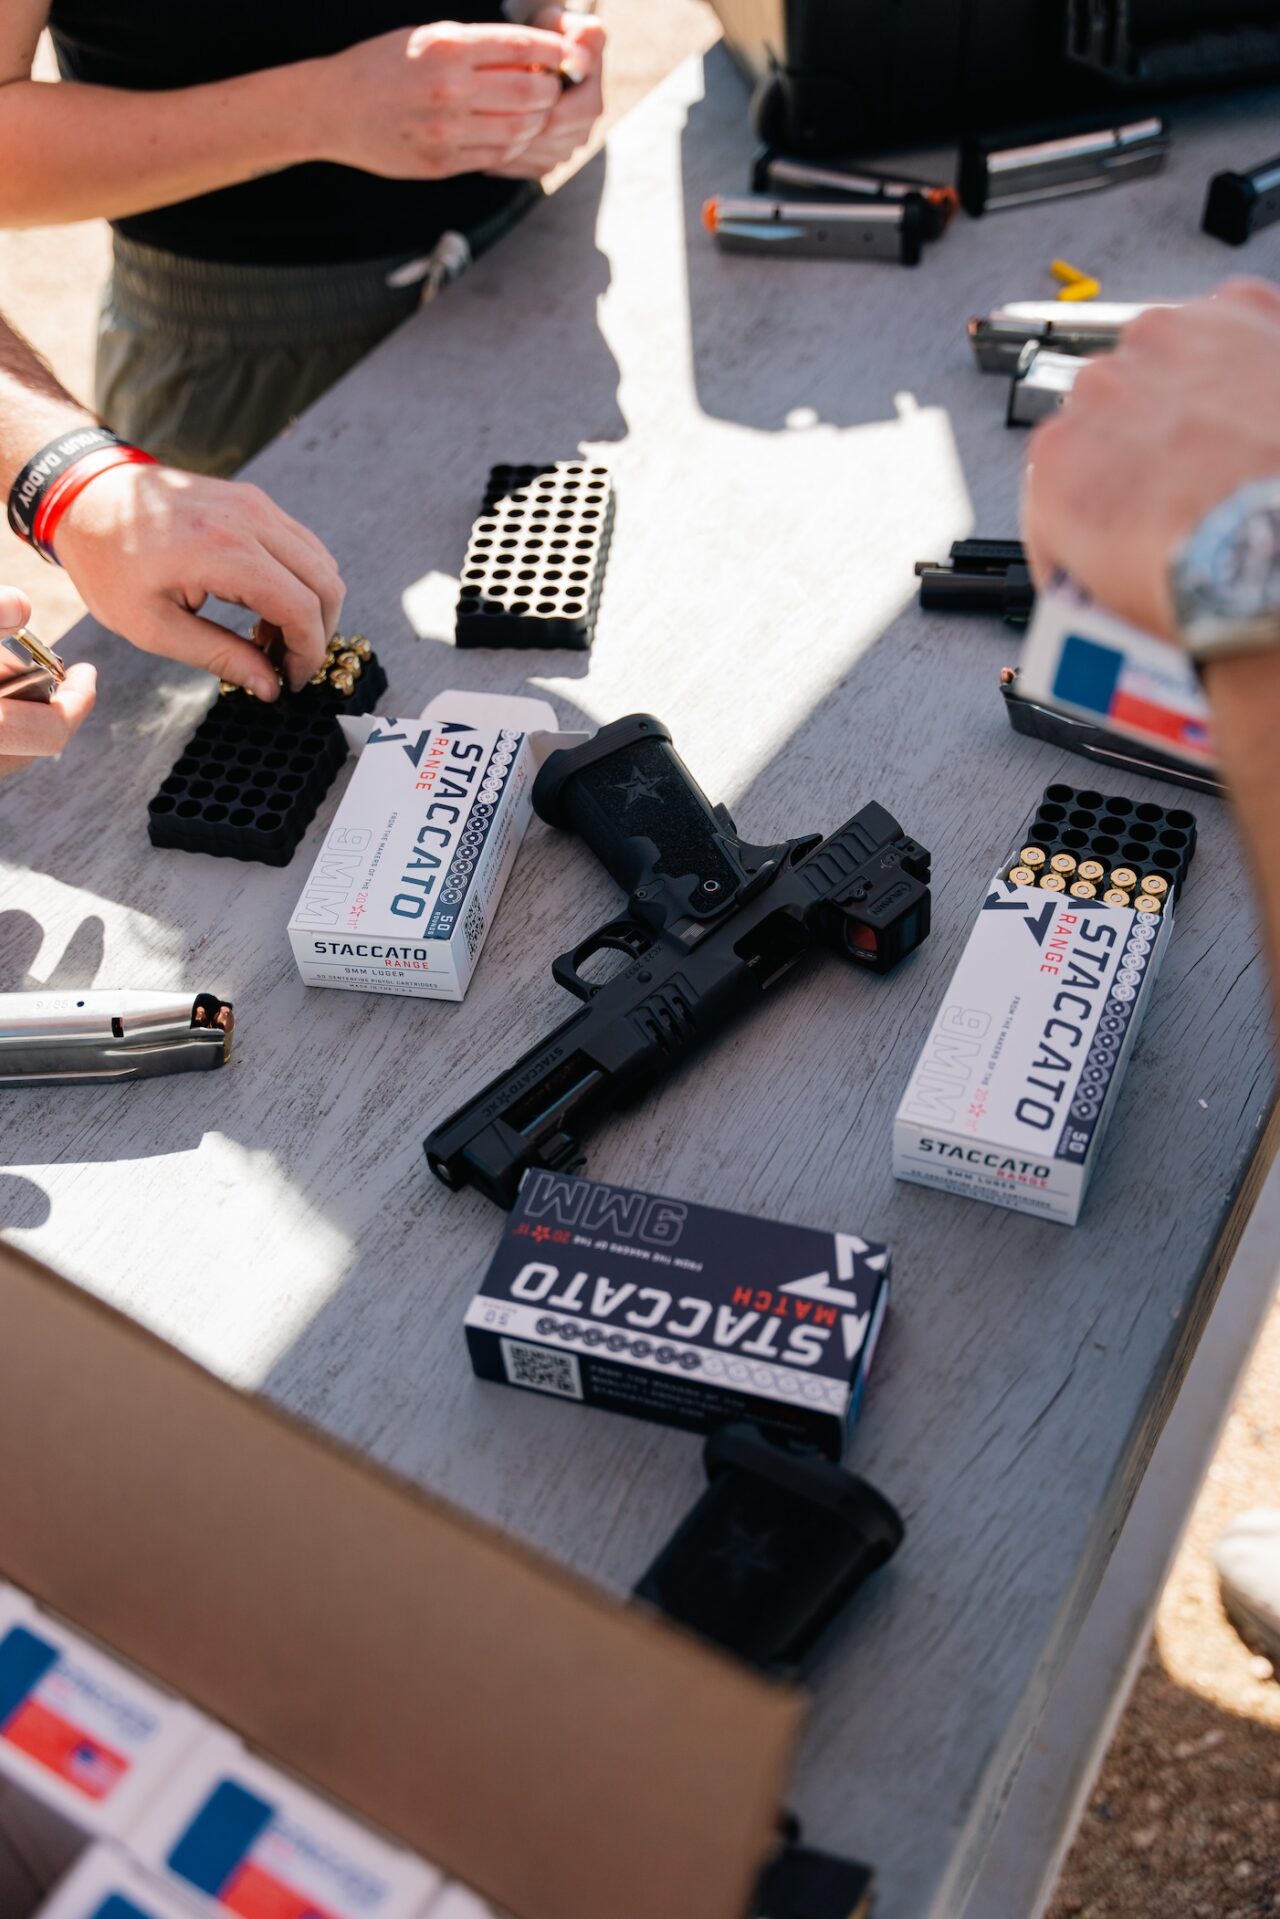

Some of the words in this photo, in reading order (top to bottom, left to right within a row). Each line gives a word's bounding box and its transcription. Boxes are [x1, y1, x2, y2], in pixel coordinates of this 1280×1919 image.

[18, 452, 62, 509] DADDY
[415, 737, 449, 792] RANGE
[387, 811, 398, 829] FROM
[390, 739, 485, 920] STACCATO
[381, 830, 391, 841] THE
[371, 842, 386, 867] MAKERS
[294, 827, 373, 926] 9MM
[361, 878, 372, 890] THE
[368, 868, 376, 877] OF
[437, 915, 454, 931] 50
[314, 941, 427, 961] STACCATO
[1039, 912, 1078, 976] RANGE
[344, 967, 368, 975] 9MM
[372, 969, 405, 977] LUGER
[384, 959, 430, 970] RANGE
[1014, 918, 1118, 1131] STACCATO
[991, 1030, 1007, 1060] MAKERS
[509, 1048, 564, 1094] STACCATO
[904, 1004, 992, 1124] 9MM
[481, 1102, 500, 1117] XC
[1069, 1131, 1089, 1154] 50
[918, 1137, 1051, 1179] STACCATO
[996, 1167, 1049, 1190] RANGE
[524, 1173, 689, 1247] 9MM
[510, 1261, 832, 1367] STACCATO
[731, 1285, 838, 1328] MATCH
